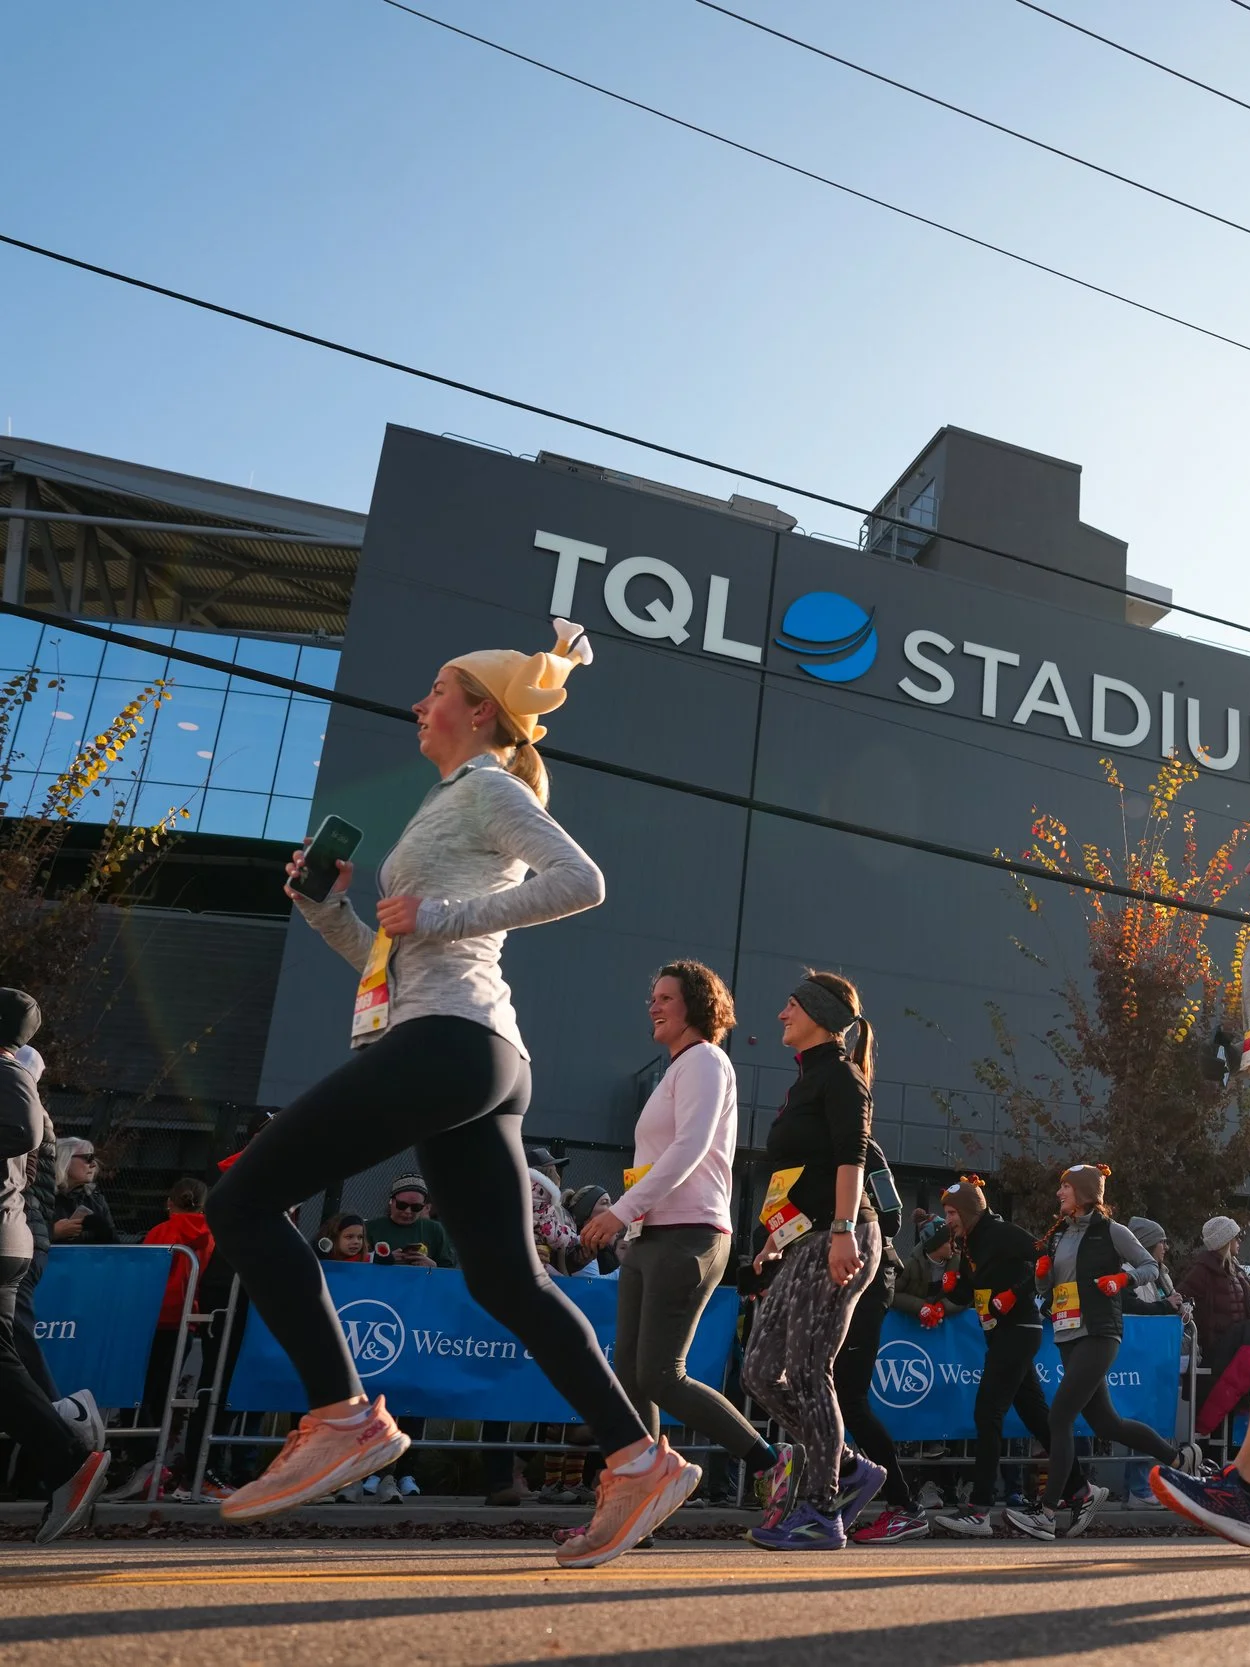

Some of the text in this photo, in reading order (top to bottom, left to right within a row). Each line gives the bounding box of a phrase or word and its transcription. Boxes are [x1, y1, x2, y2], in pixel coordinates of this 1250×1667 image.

[533, 529, 765, 665] TQL
[767, 1211, 785, 1231] 3679
[411, 1329, 517, 1359] Western
[875, 1358, 928, 1393] W&S
[1035, 1362, 1051, 1383] &
